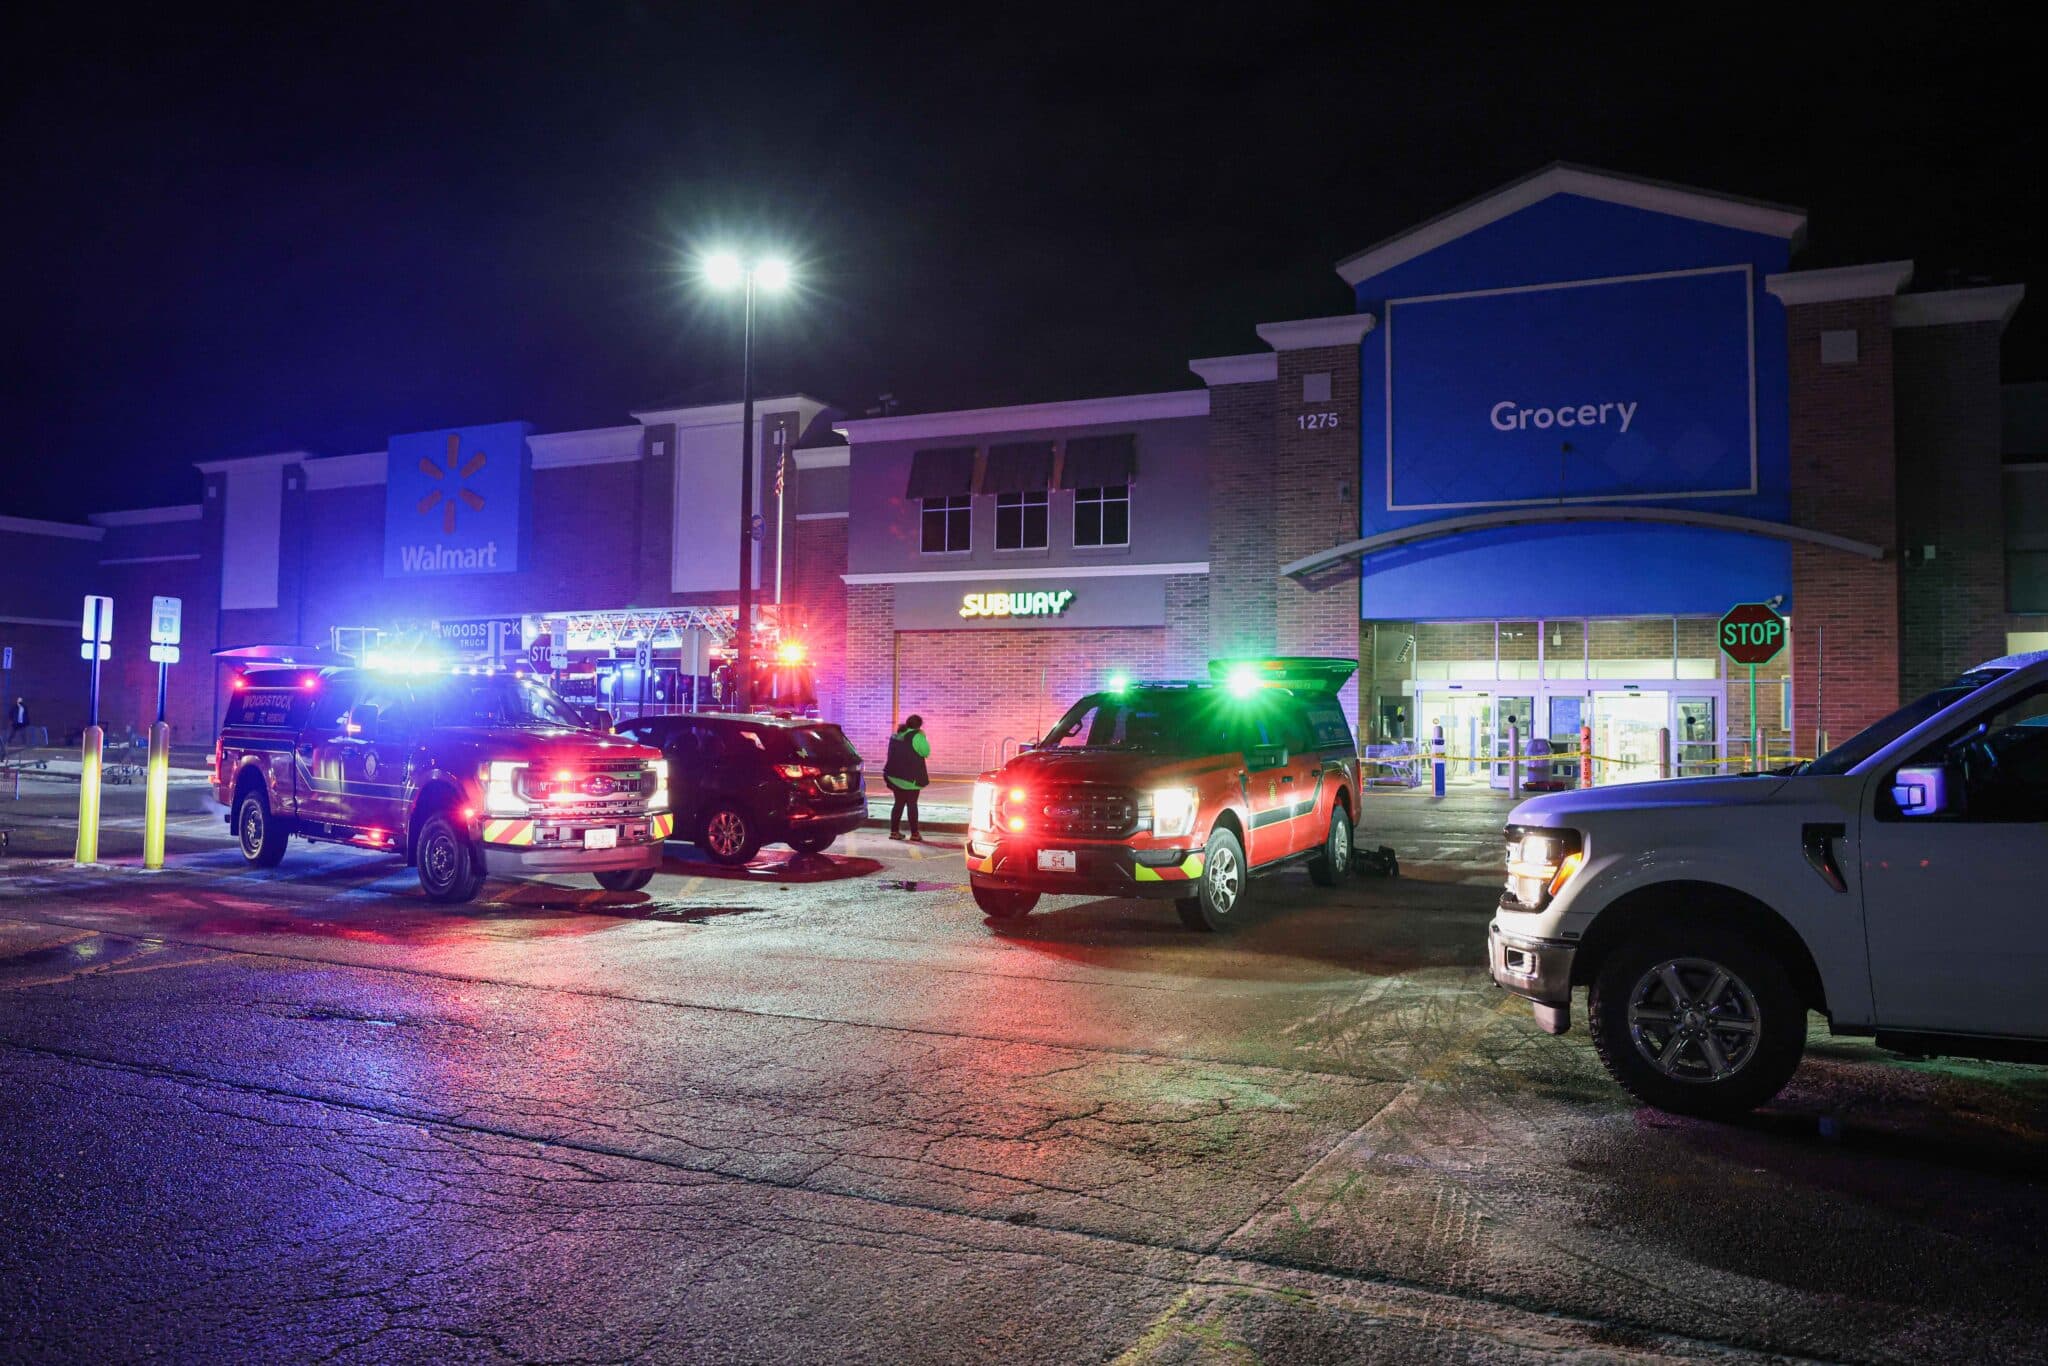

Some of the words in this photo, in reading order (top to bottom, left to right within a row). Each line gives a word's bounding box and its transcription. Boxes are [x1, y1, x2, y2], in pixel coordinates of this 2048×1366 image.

[1297, 412, 1338, 430] 1275
[1490, 401, 1638, 433] Grocery
[401, 541, 497, 571] Walmart
[960, 590, 1072, 617] SUBWAY
[442, 621, 520, 638] WOODSCK
[1724, 622, 1781, 646] STOP
[460, 638, 486, 648] TRUCK
[531, 646, 552, 662] STO
[639, 650, 647, 668] 8
[242, 695, 294, 711] WOODSTOCK
